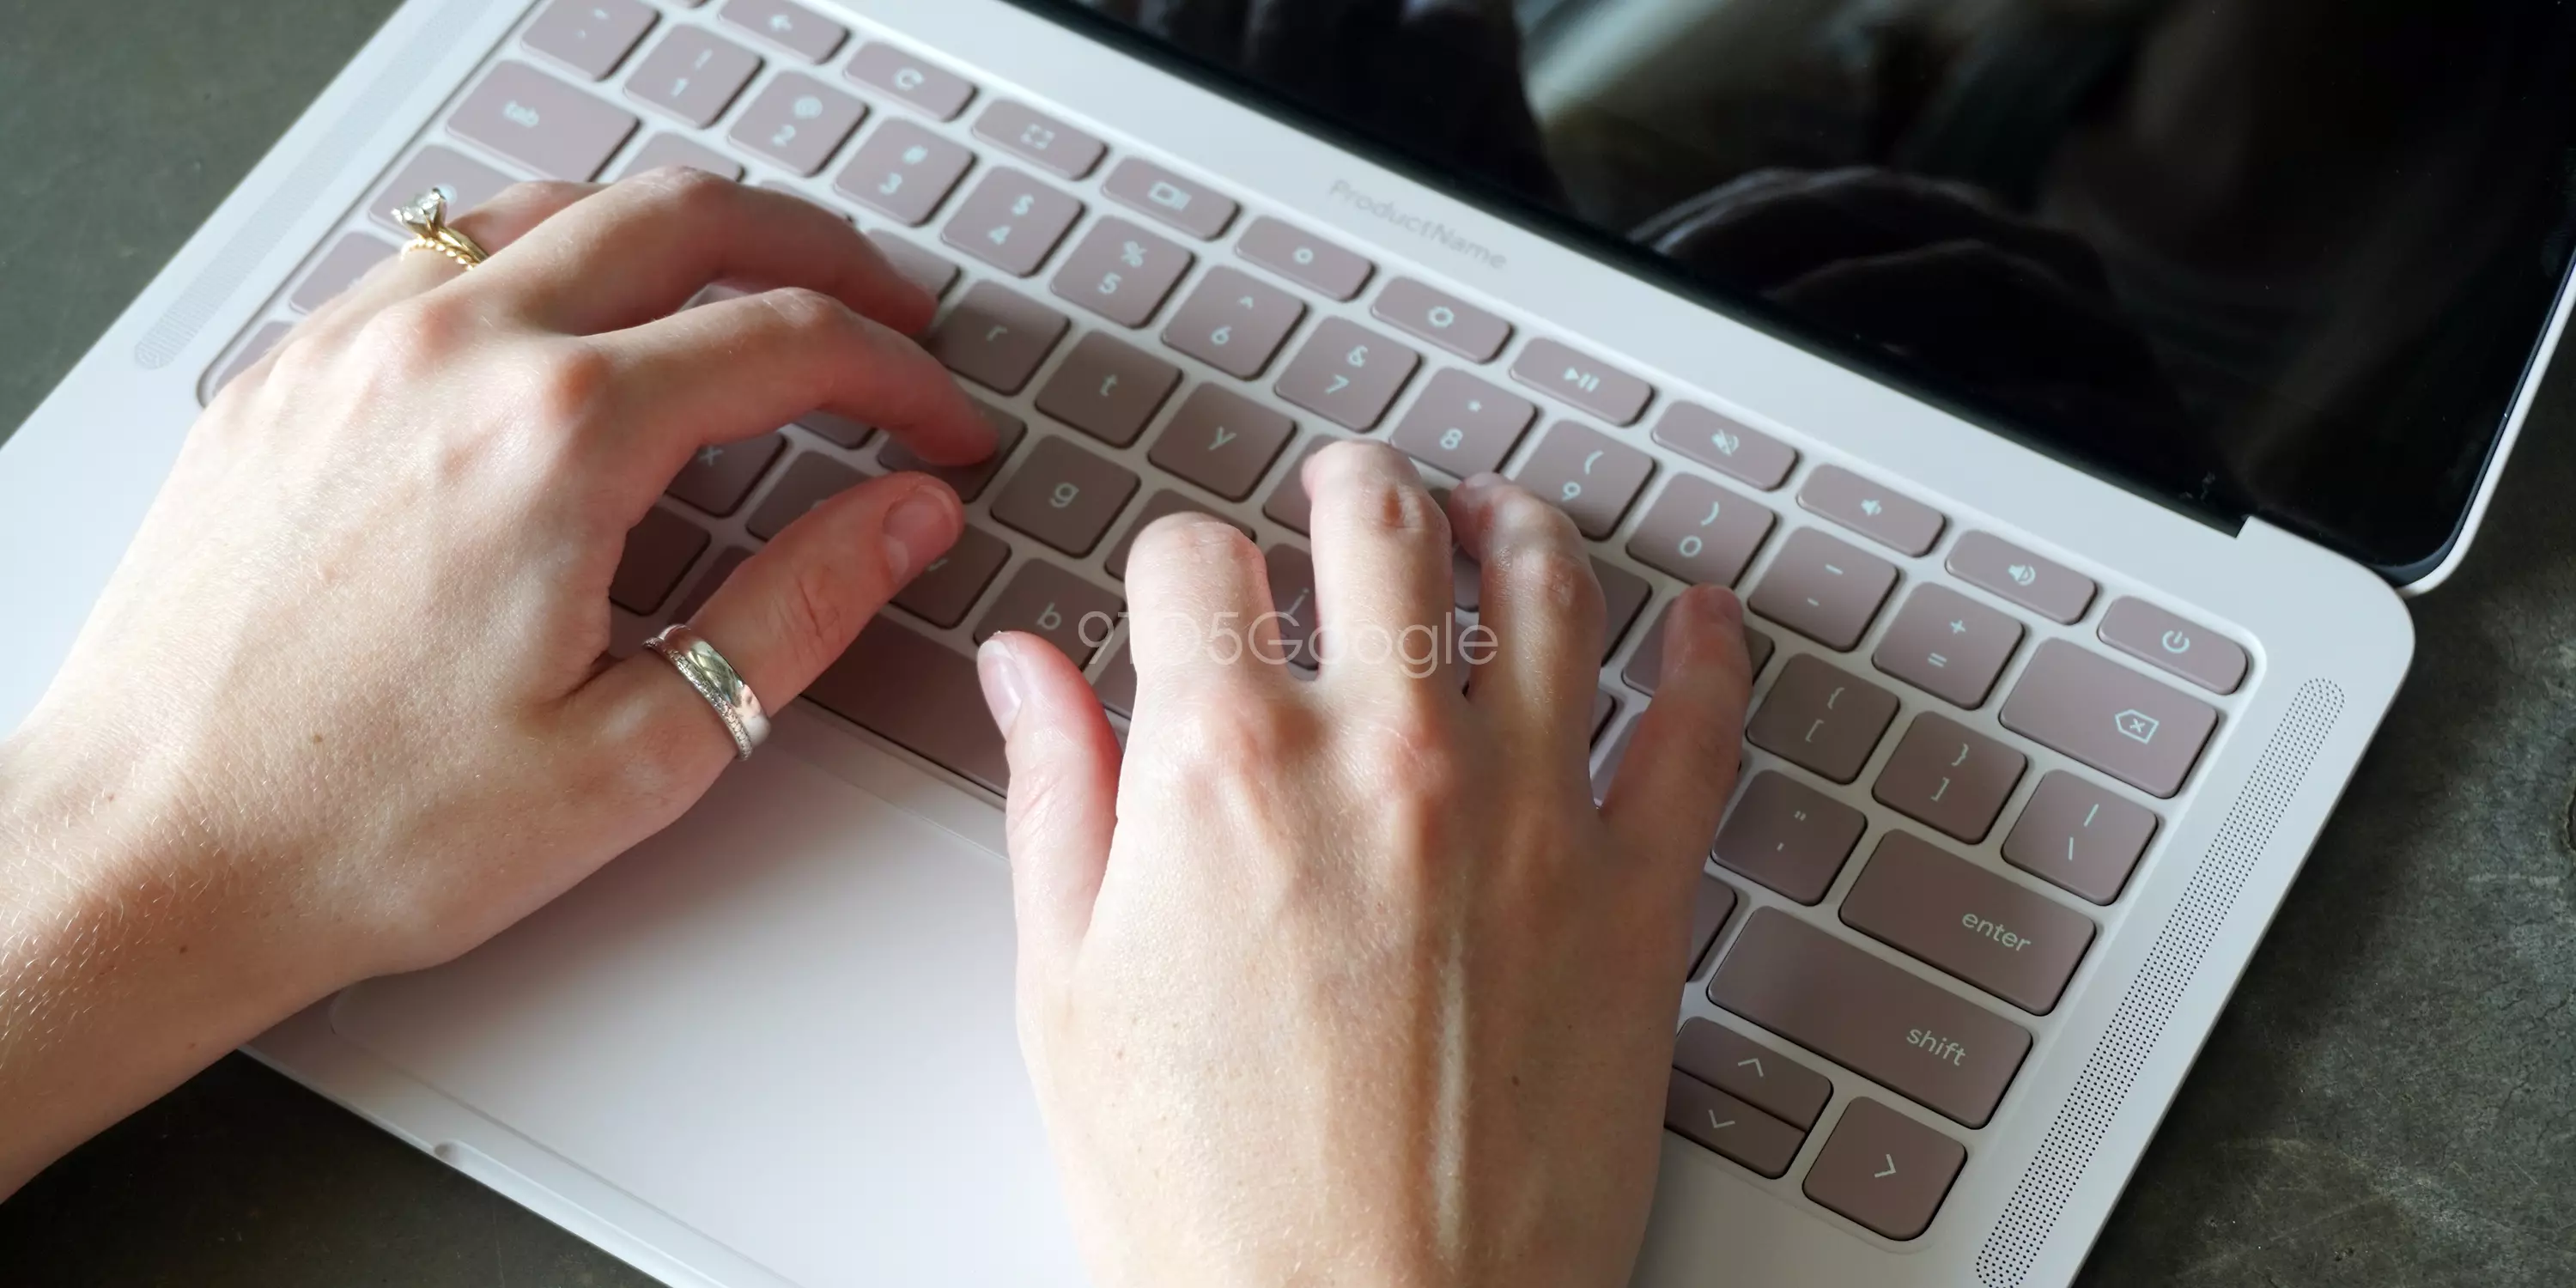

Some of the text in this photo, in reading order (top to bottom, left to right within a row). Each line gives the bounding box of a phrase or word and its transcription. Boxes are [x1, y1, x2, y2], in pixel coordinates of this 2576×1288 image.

[671, 77, 689, 98] 1
[502, 100, 540, 127] tab
[772, 125, 797, 147] 2
[879, 171, 903, 195] 3
[1011, 194, 1035, 216] $
[987, 225, 1012, 246] 4
[1121, 240, 1147, 268] %
[1097, 271, 1122, 295] 5
[986, 325, 1008, 342] r
[1210, 325, 1232, 346] 6
[1347, 344, 1369, 368] &
[1099, 374, 1119, 398] t
[1324, 374, 1351, 395] 7
[1207, 425, 1237, 452] y
[1439, 427, 1464, 450] 8
[1583, 450, 1604, 476] (
[1049, 482, 1080, 509] g
[1561, 480, 1583, 501] 9
[1699, 501, 1720, 526] )
[1036, 602, 1063, 631] b
[1949, 619, 1967, 635] +
[1927, 651, 1948, 668] =
[1826, 686, 1846, 711] {
[1804, 718, 1825, 744] [
[1950, 742, 1970, 768] }
[1929, 776, 1951, 803] ]
[1961, 909, 2032, 952] enter
[1905, 1027, 1967, 1067] shift
